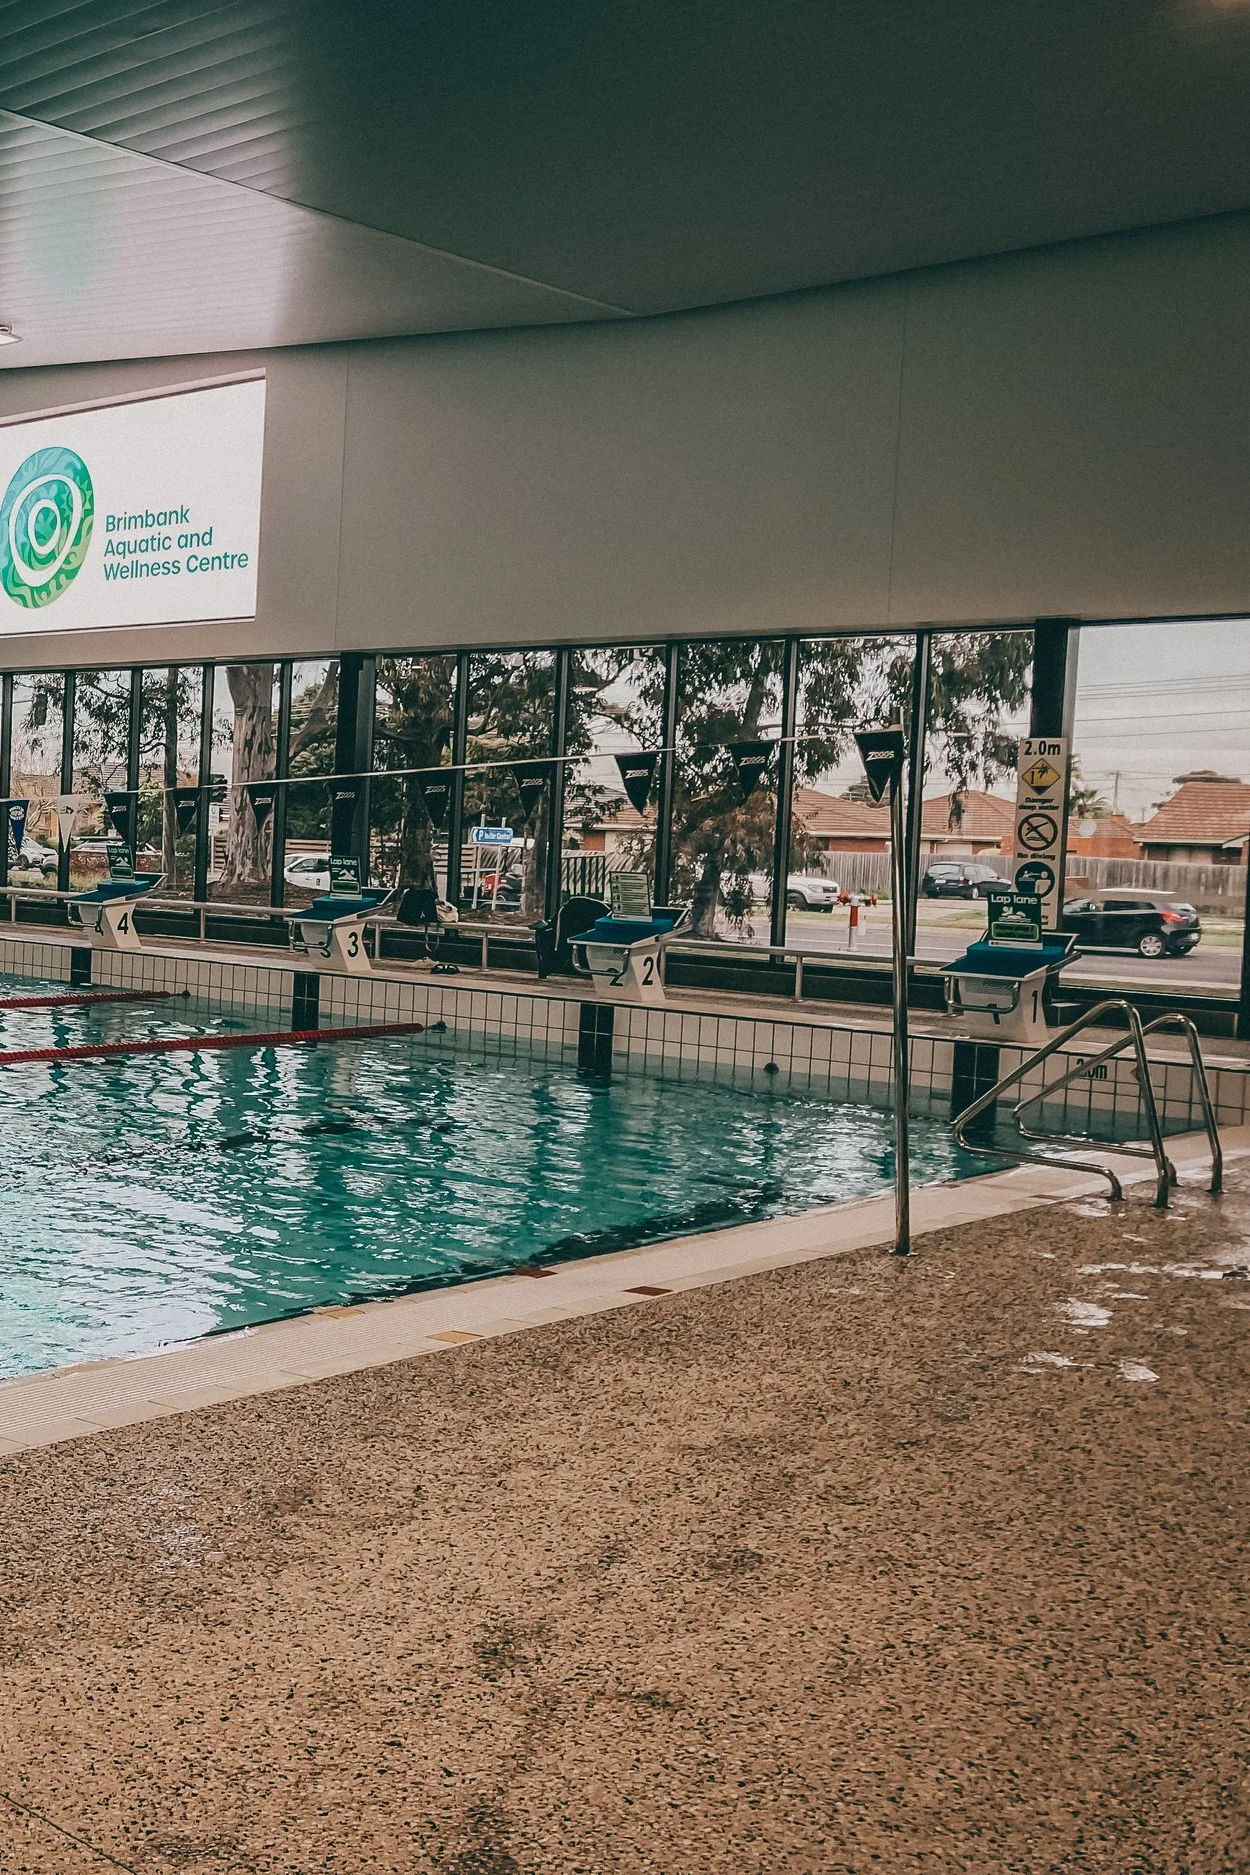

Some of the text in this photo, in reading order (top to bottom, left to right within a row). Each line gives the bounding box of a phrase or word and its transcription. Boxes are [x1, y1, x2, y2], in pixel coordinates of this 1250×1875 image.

[105, 505, 190, 533] Brimbank
[104, 527, 213, 559] Aquatic and
[103, 551, 249, 581] Wellness Centre
[1024, 740, 1061, 755] 2.0m
[330, 858, 342, 866] Lap
[991, 894, 1038, 904] Lap lane
[117, 912, 129, 935] 4
[347, 931, 359, 957] 3
[642, 956, 654, 985] 2
[1031, 990, 1039, 1023] 1
